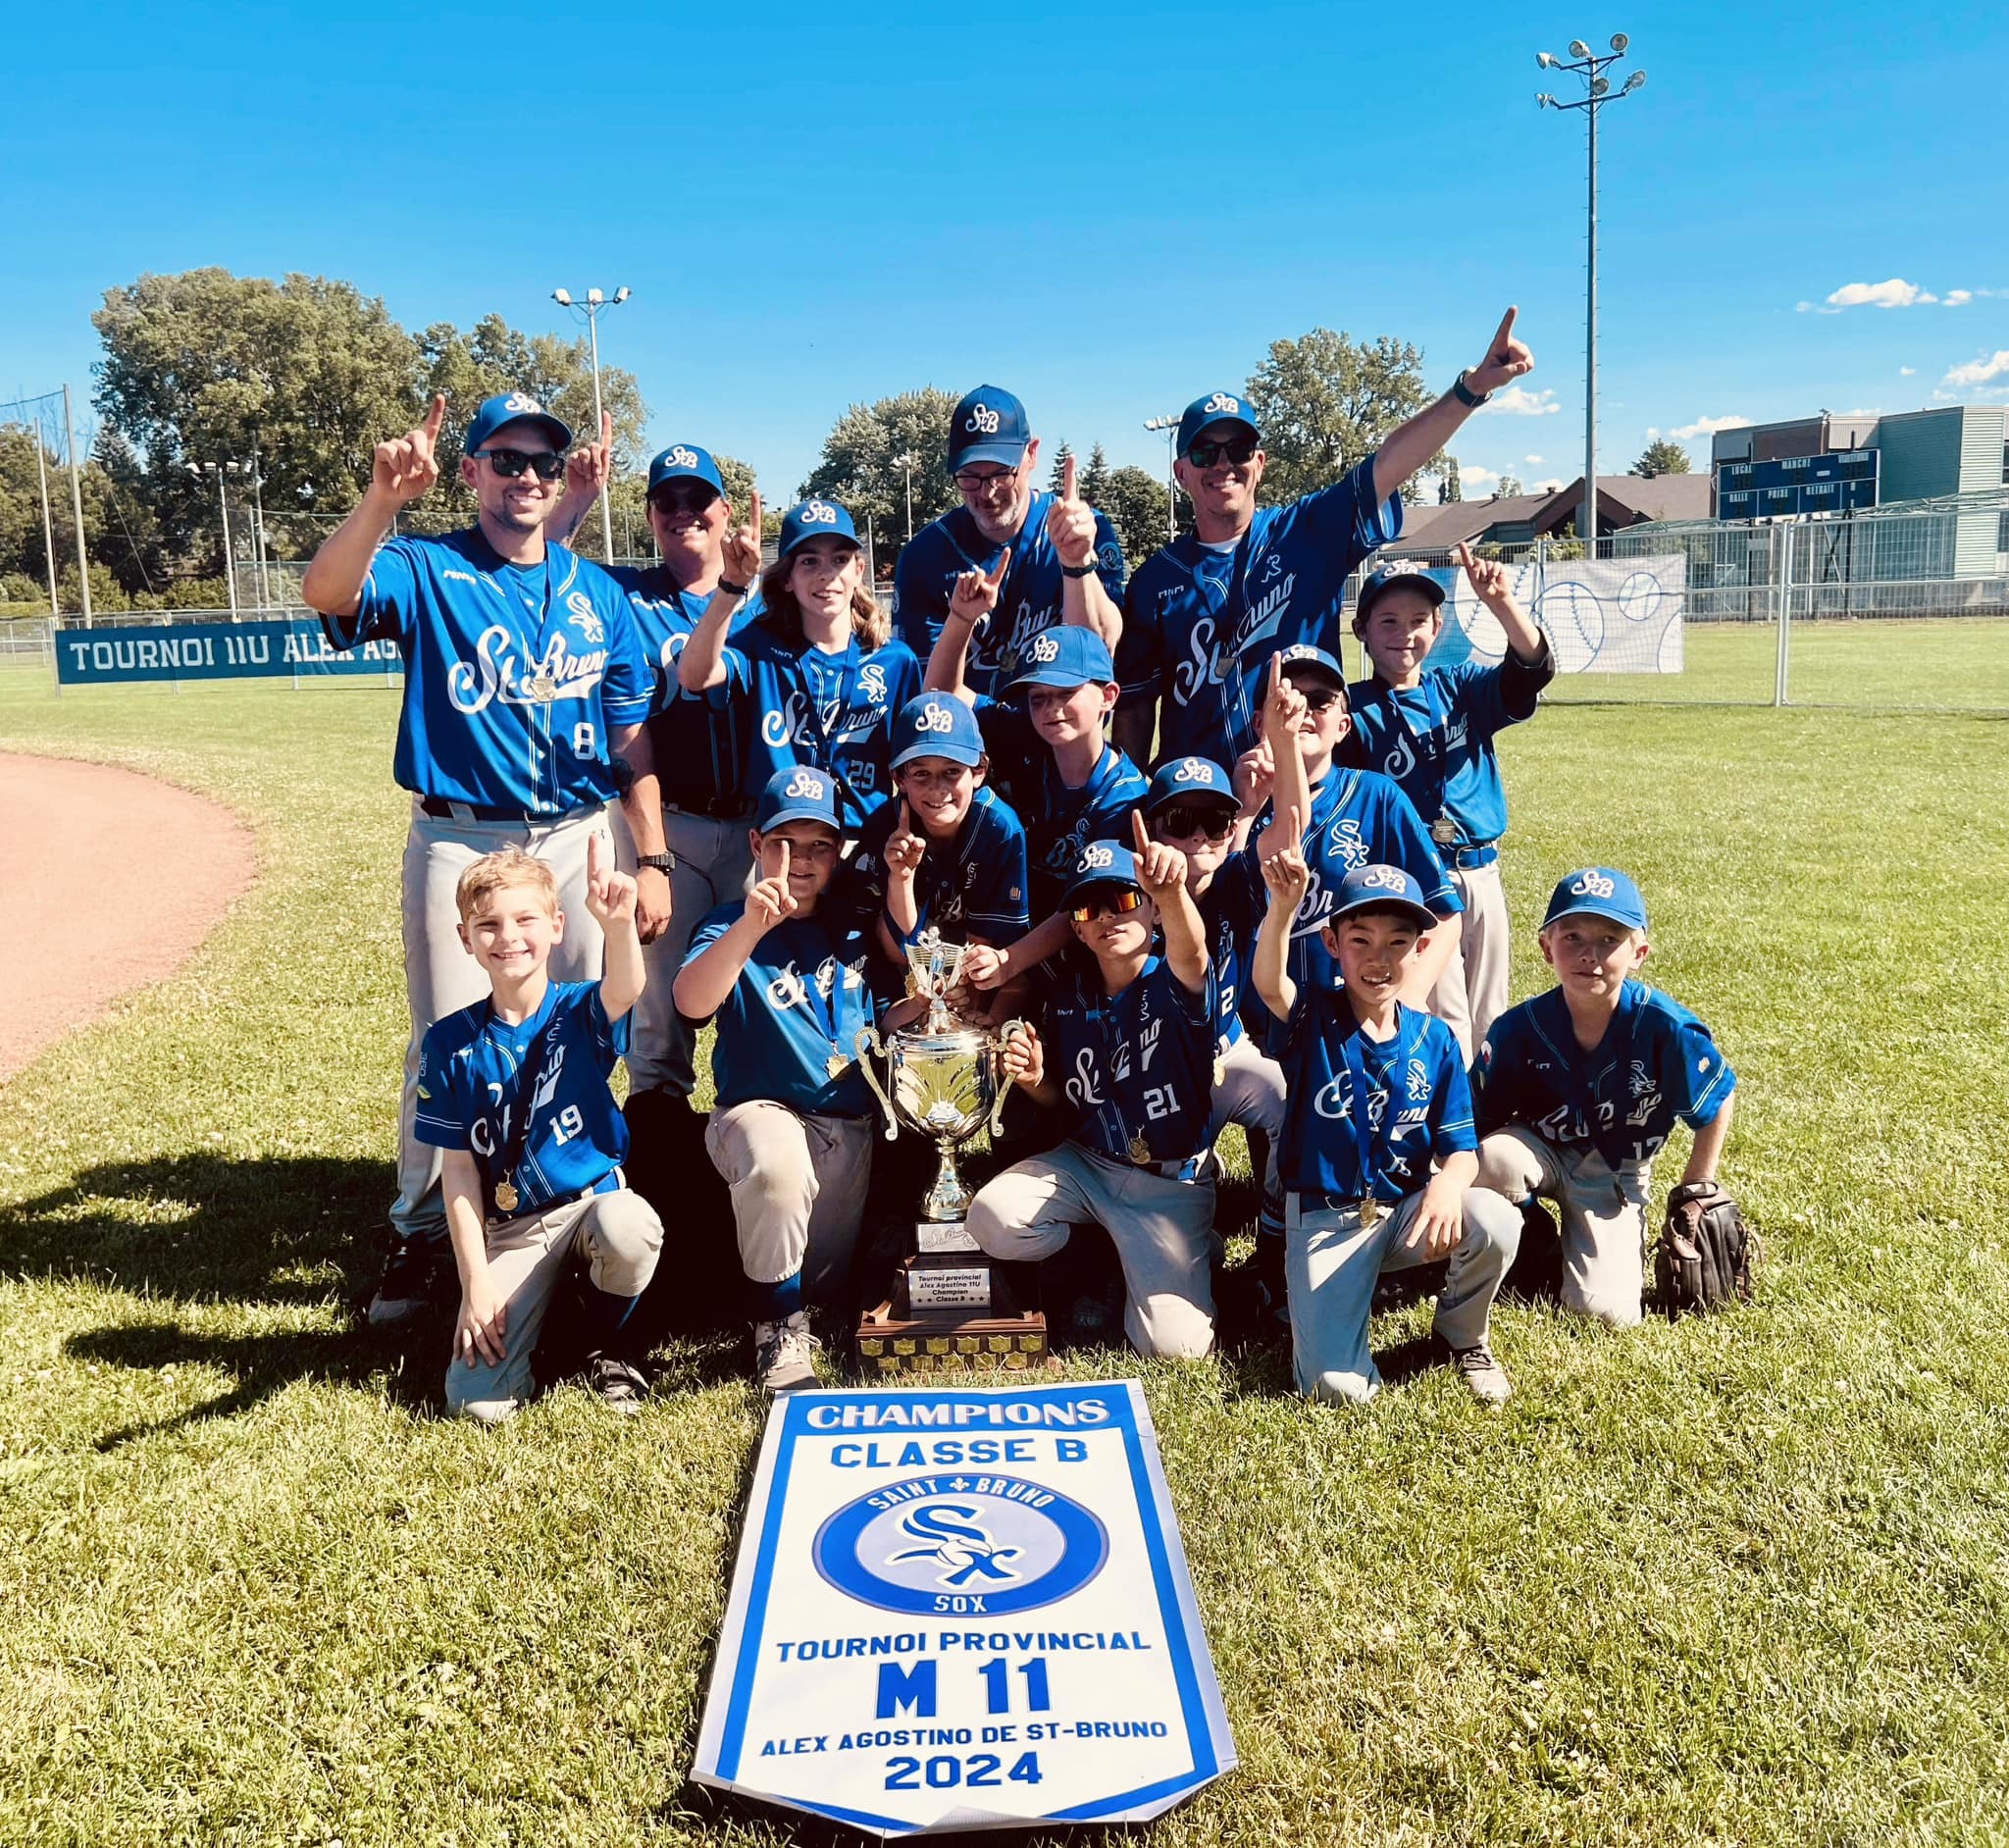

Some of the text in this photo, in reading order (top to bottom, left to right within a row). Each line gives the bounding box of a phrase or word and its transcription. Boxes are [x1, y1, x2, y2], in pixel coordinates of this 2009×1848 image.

[70, 638, 215, 671] TOURNOI
[225, 636, 270, 665] 11U
[363, 639, 402, 660] AG
[574, 722, 595, 760] 8
[849, 760, 875, 789] 29
[1143, 1083, 1181, 1120] 21
[549, 1104, 584, 1147] 19
[806, 1399, 1110, 1429] CHAMPIONS
[830, 1438, 1088, 1468] CLASSE B
[867, 1477, 1056, 1512] SAINT BRUNO
[933, 1595, 987, 1613] SOX
[776, 1630, 1153, 1663] TOURNOI PROVINCIAL
[874, 1657, 1052, 1720] M 11
[760, 1721, 1168, 1757] ALEX AGOSTINO DE ST-BRUNO
[884, 1751, 1044, 1791] 2024
